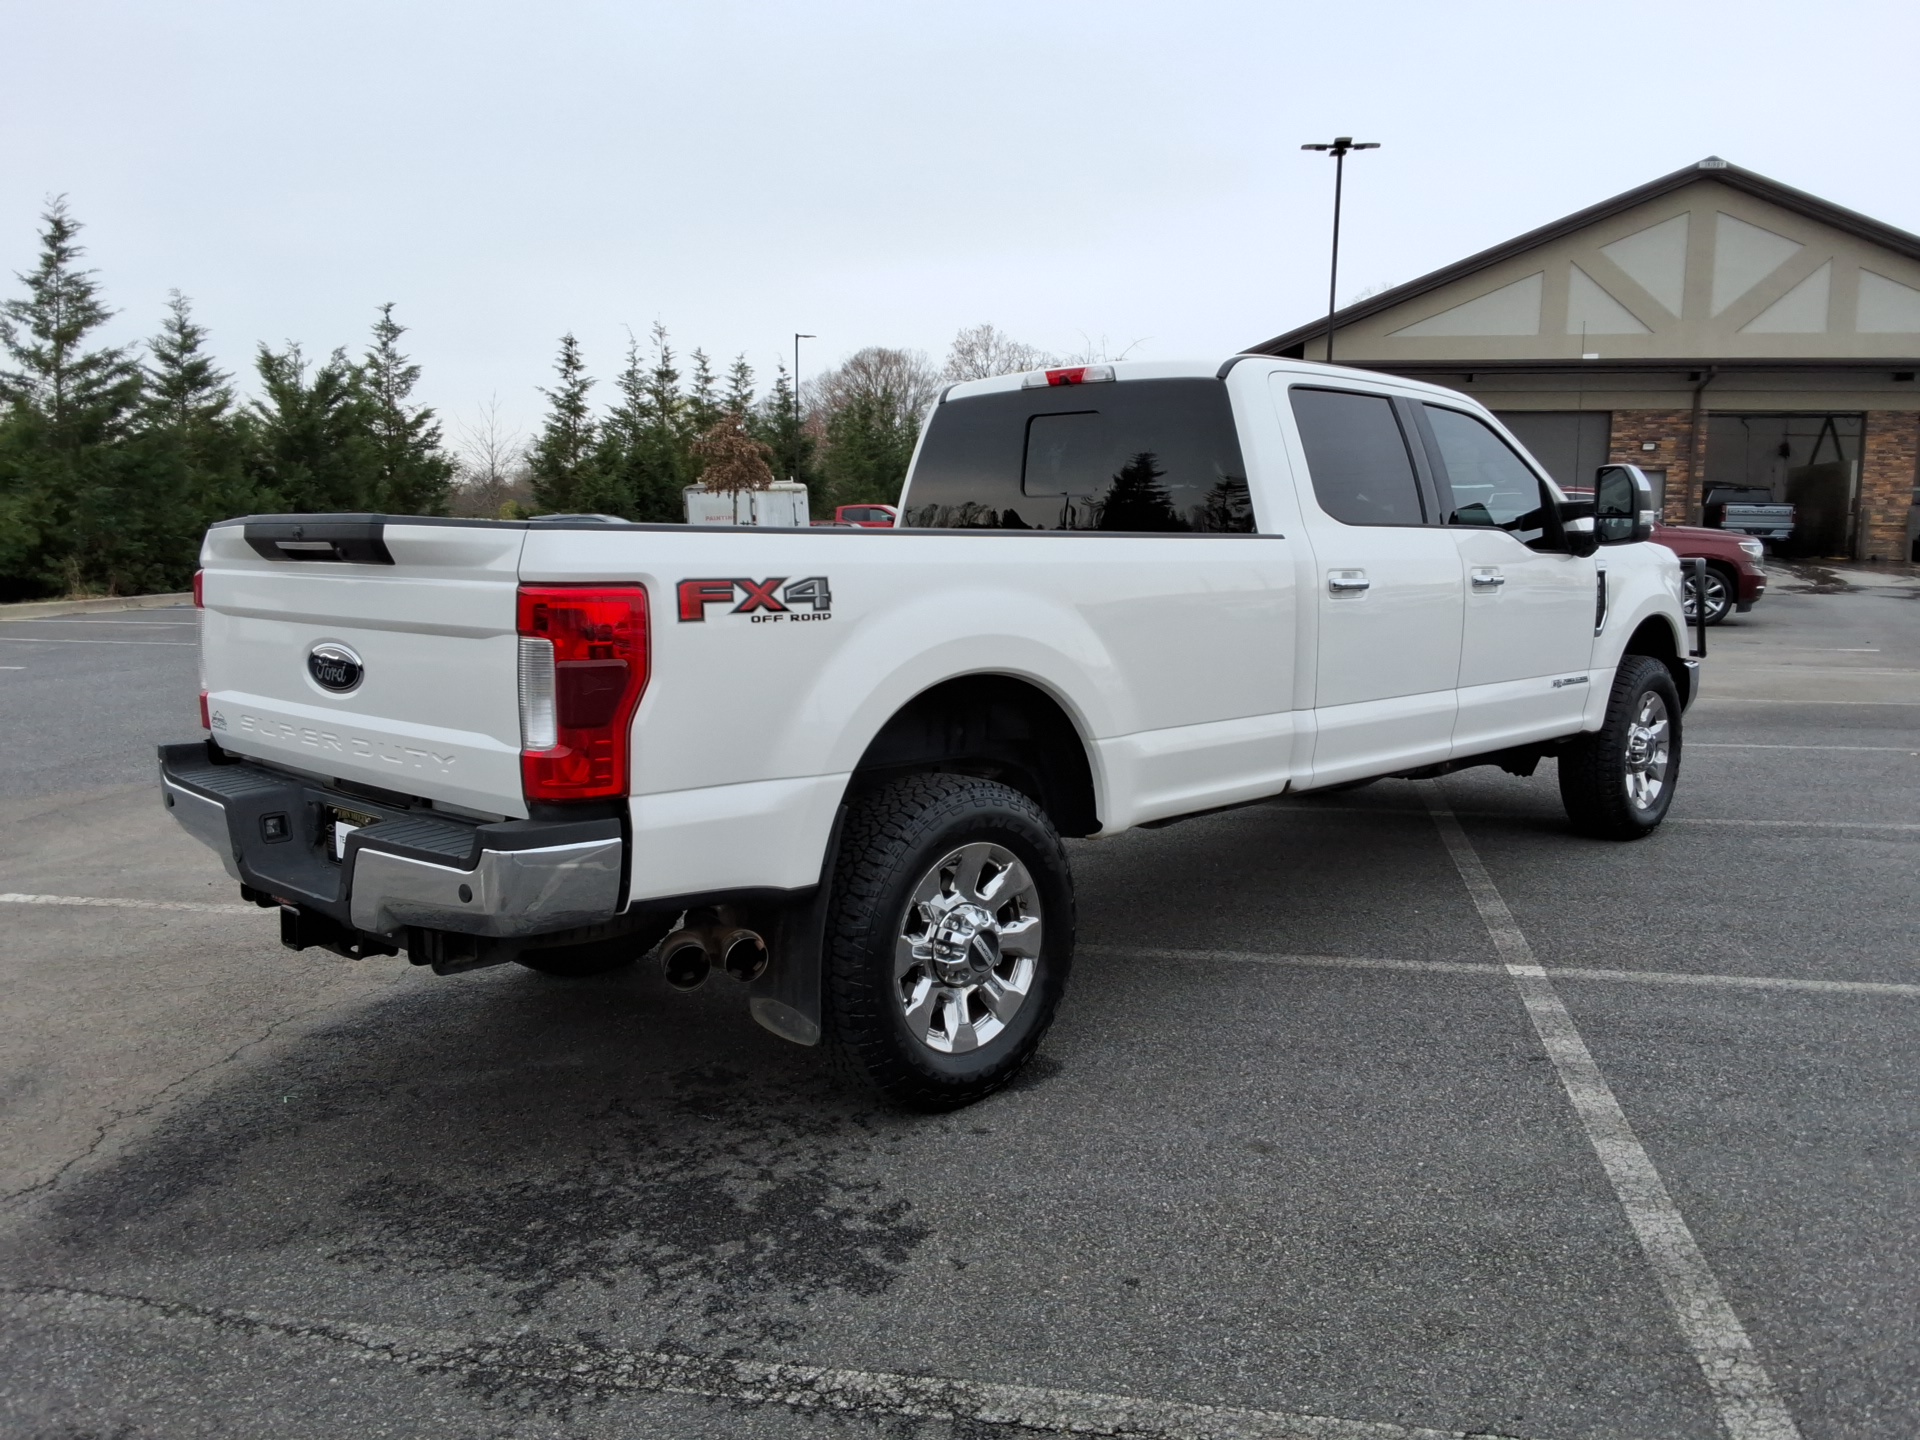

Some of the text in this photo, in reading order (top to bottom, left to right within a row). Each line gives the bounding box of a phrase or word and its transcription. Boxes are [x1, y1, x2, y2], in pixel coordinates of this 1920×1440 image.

[676, 576, 832, 623] FX4
[751, 613, 832, 623] OFF ROAD
[316, 658, 347, 682] Ford
[241, 714, 456, 773] SUPER DUTY
